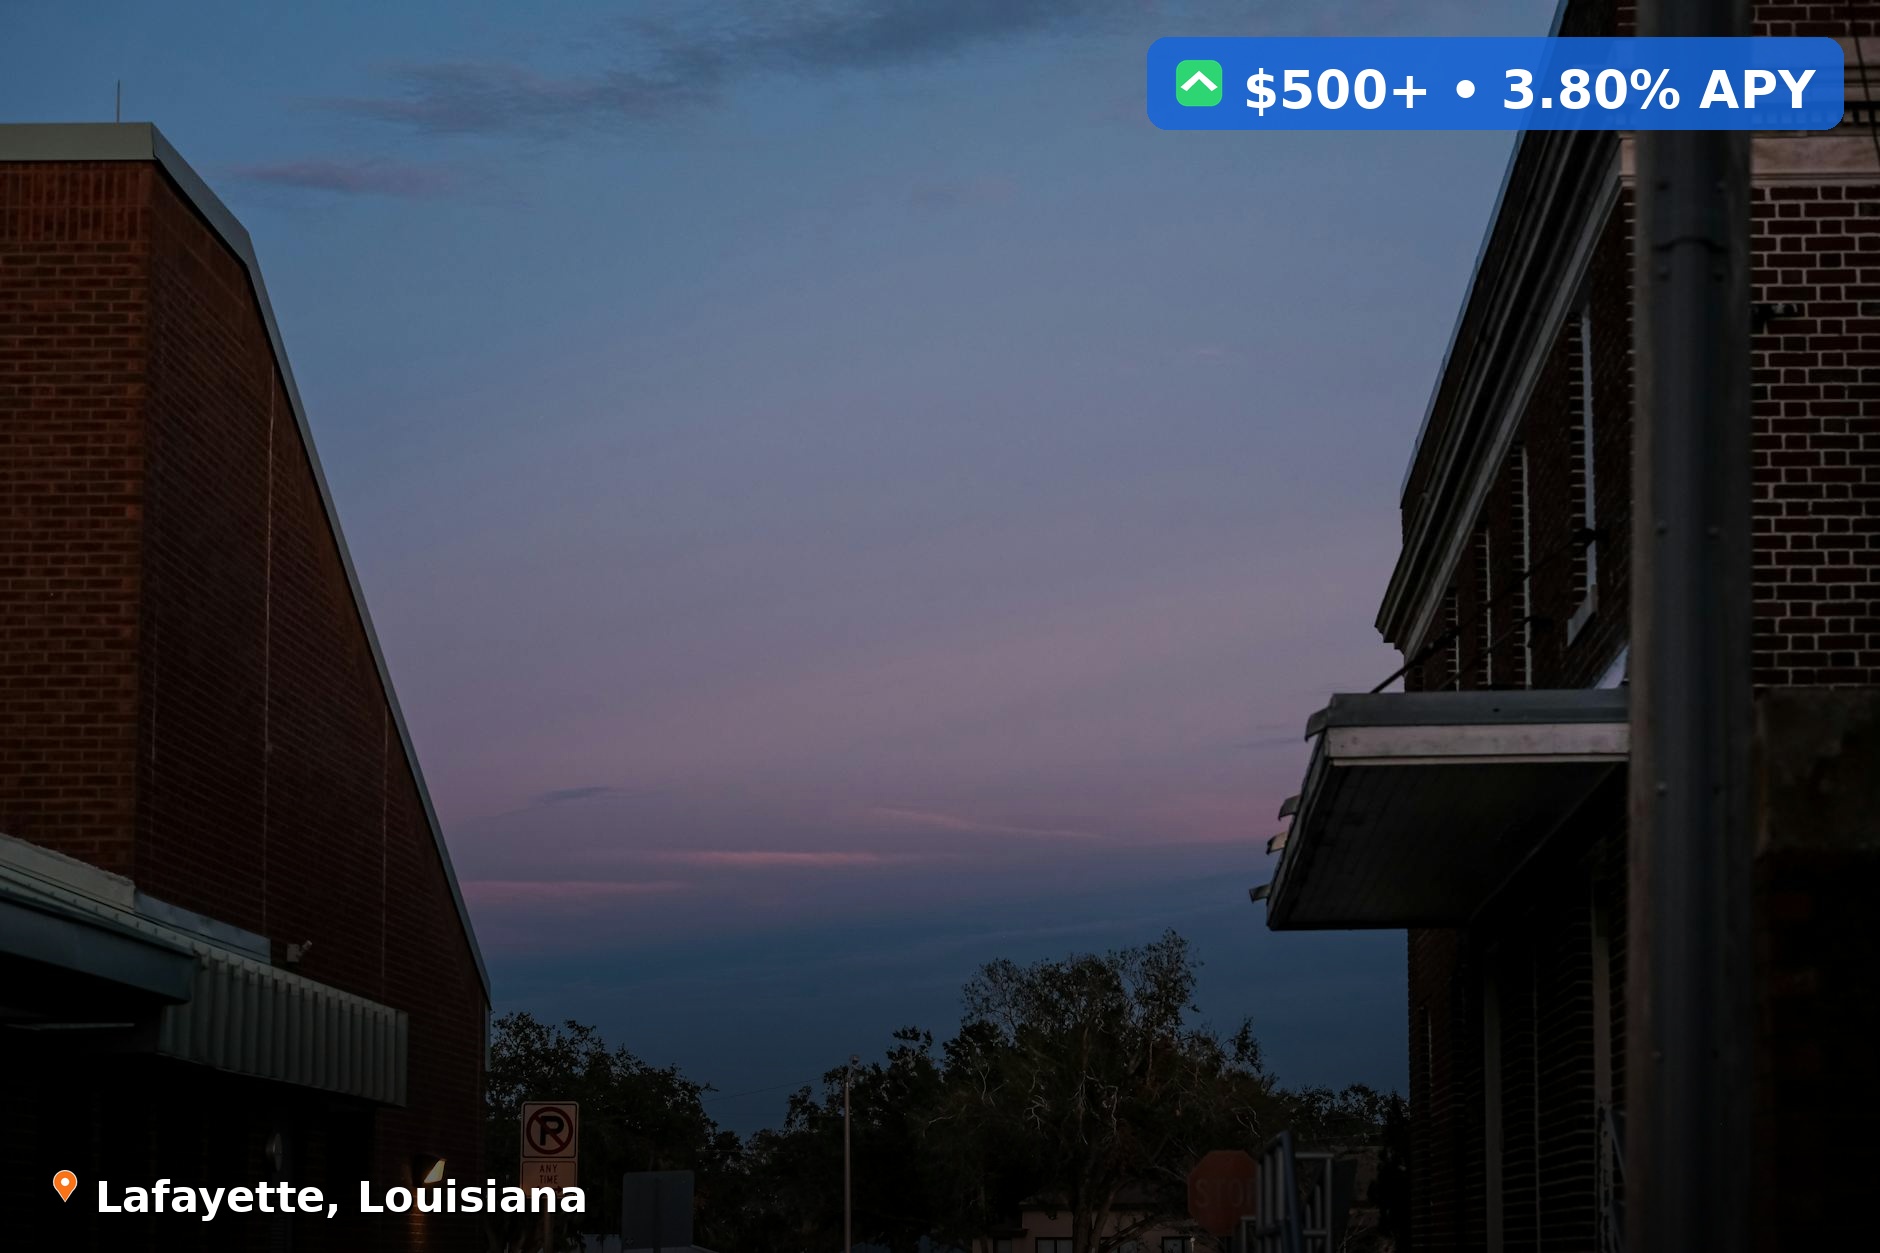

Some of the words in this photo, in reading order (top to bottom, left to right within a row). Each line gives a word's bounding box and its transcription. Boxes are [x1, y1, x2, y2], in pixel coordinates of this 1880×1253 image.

[540, 1115, 564, 1146] P
[540, 1164, 558, 1173] ANY
[540, 1175, 558, 1184] TIME
